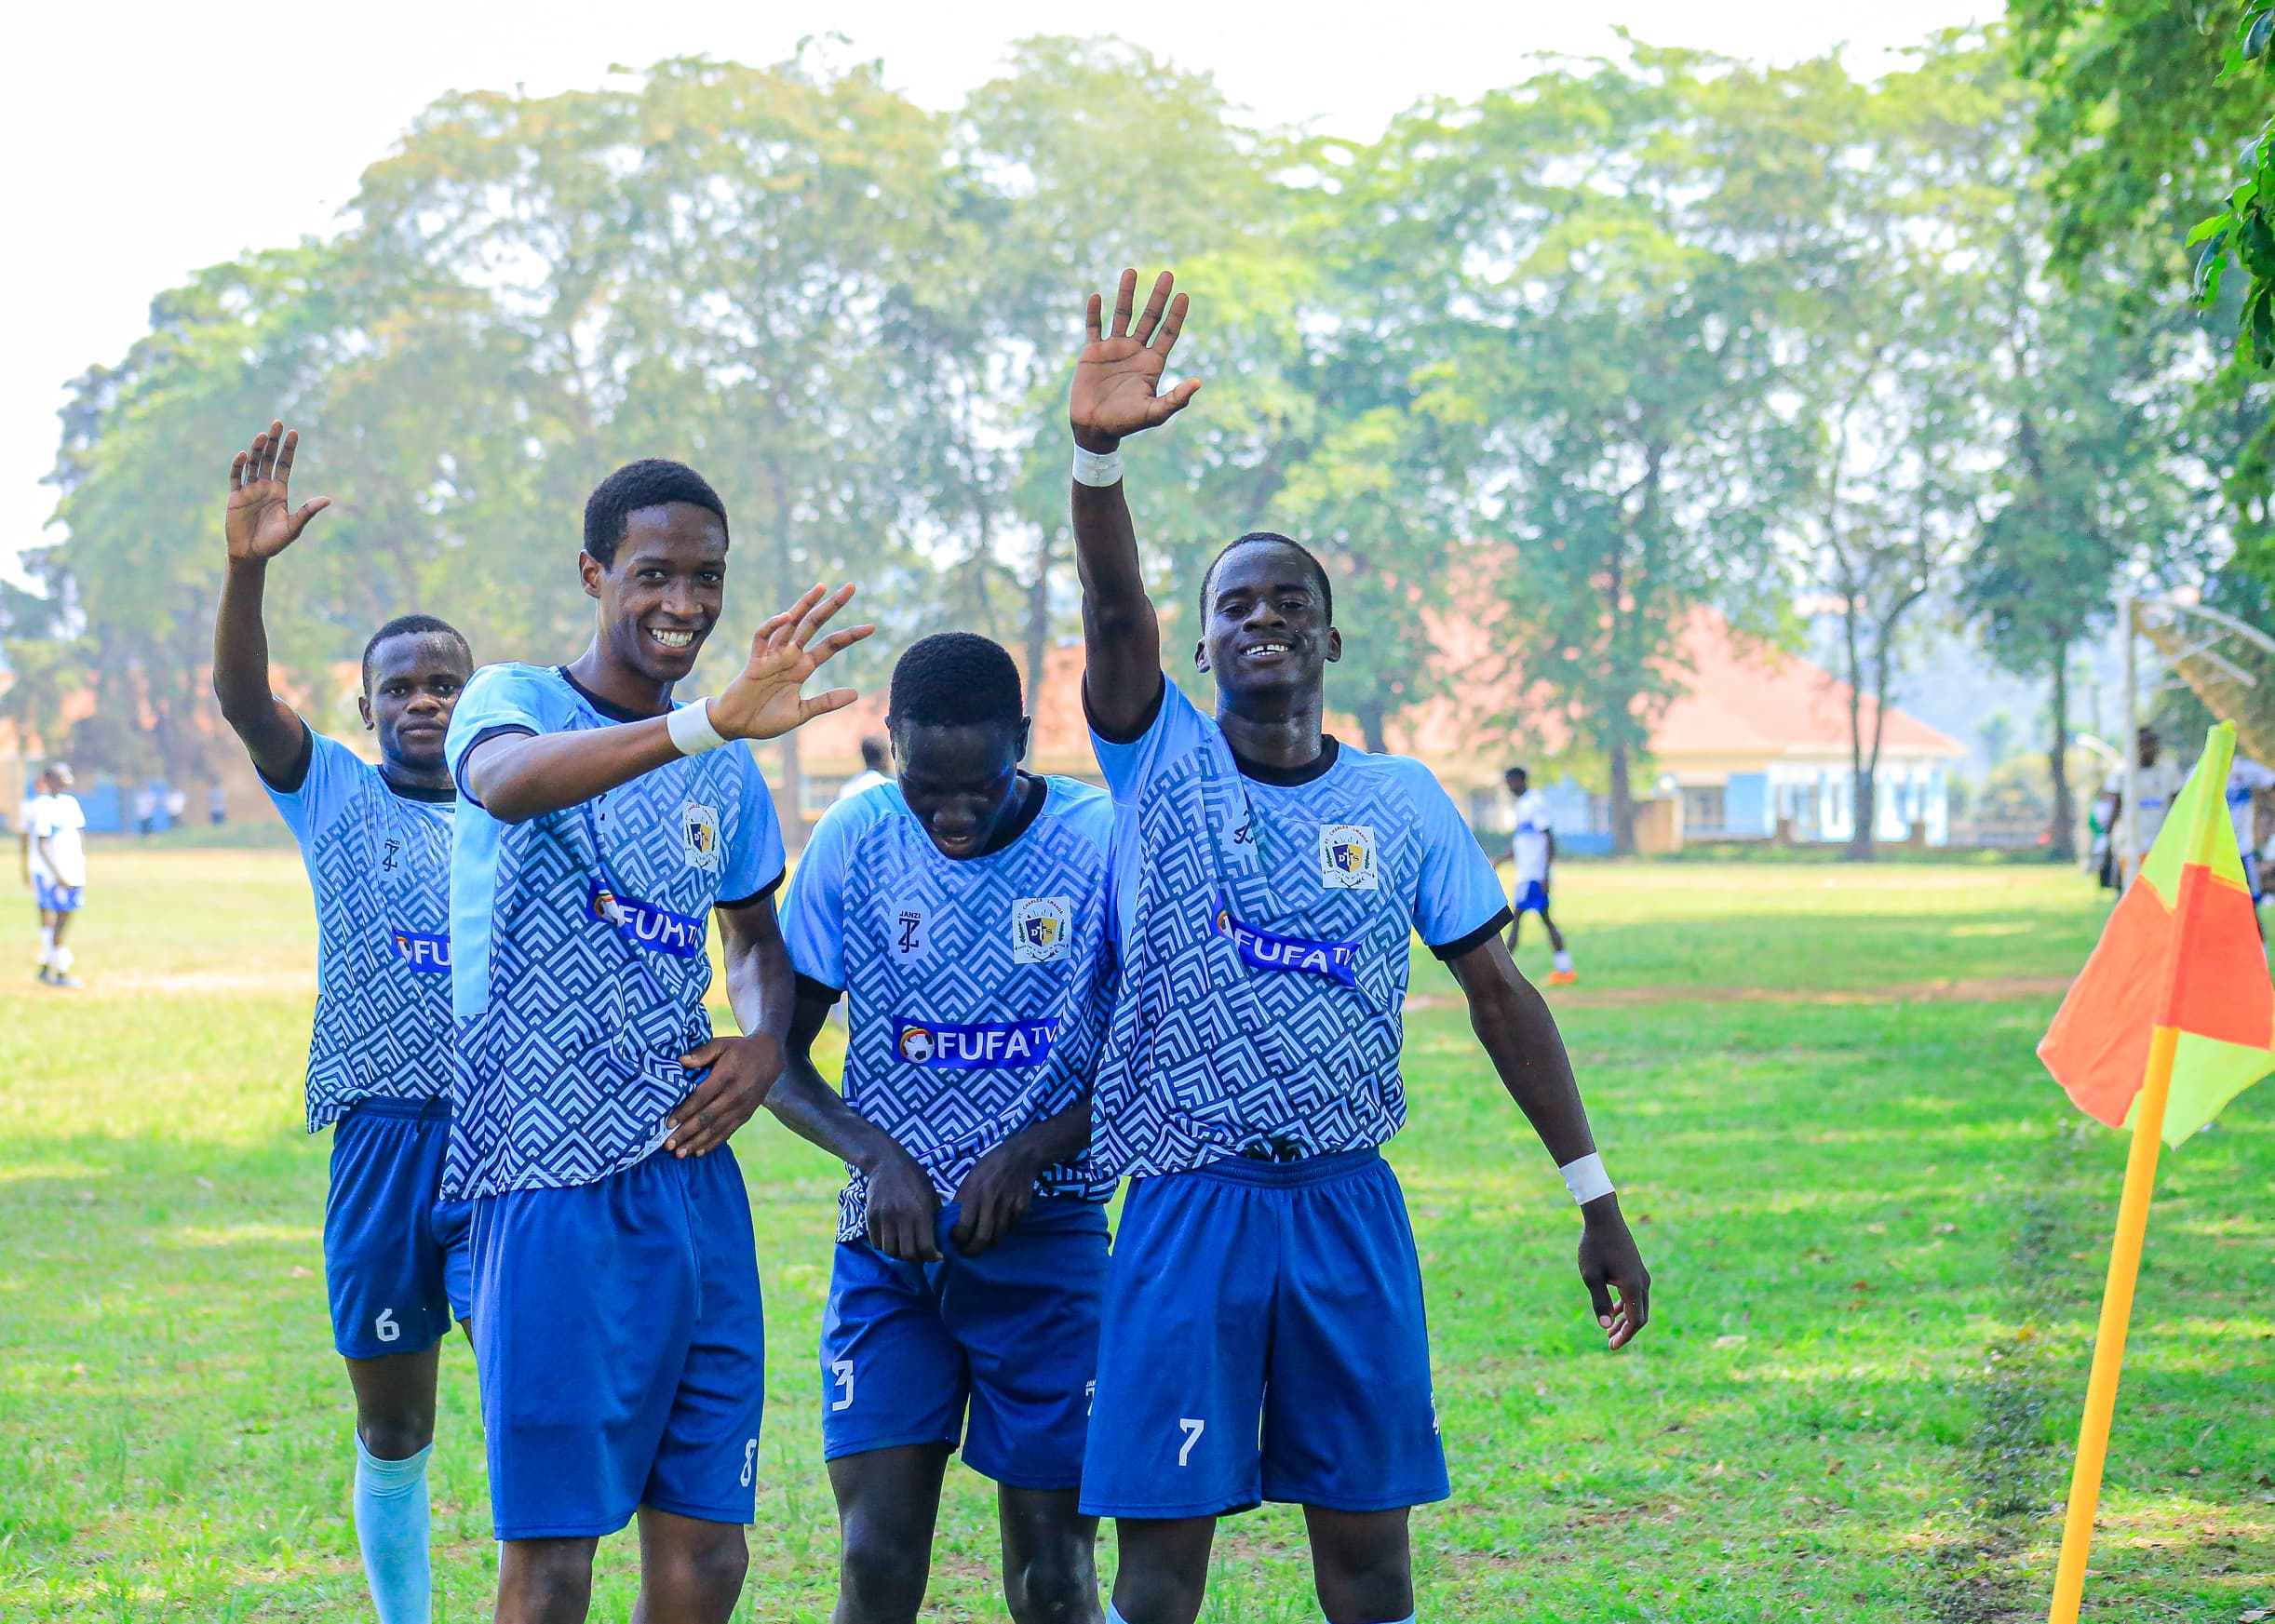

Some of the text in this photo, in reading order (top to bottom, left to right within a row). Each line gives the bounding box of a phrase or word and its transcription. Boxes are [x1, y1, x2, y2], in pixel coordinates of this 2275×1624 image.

[899, 910, 921, 919] JANZI
[1022, 898, 1043, 910] CHARLES
[1234, 928, 1328, 973] FUFA
[937, 1025, 1057, 1060] FUFA TV
[376, 1309, 400, 1342] 6
[831, 1360, 854, 1412] 3
[1178, 1417, 1205, 1467] 7
[740, 1438, 758, 1487] 8
